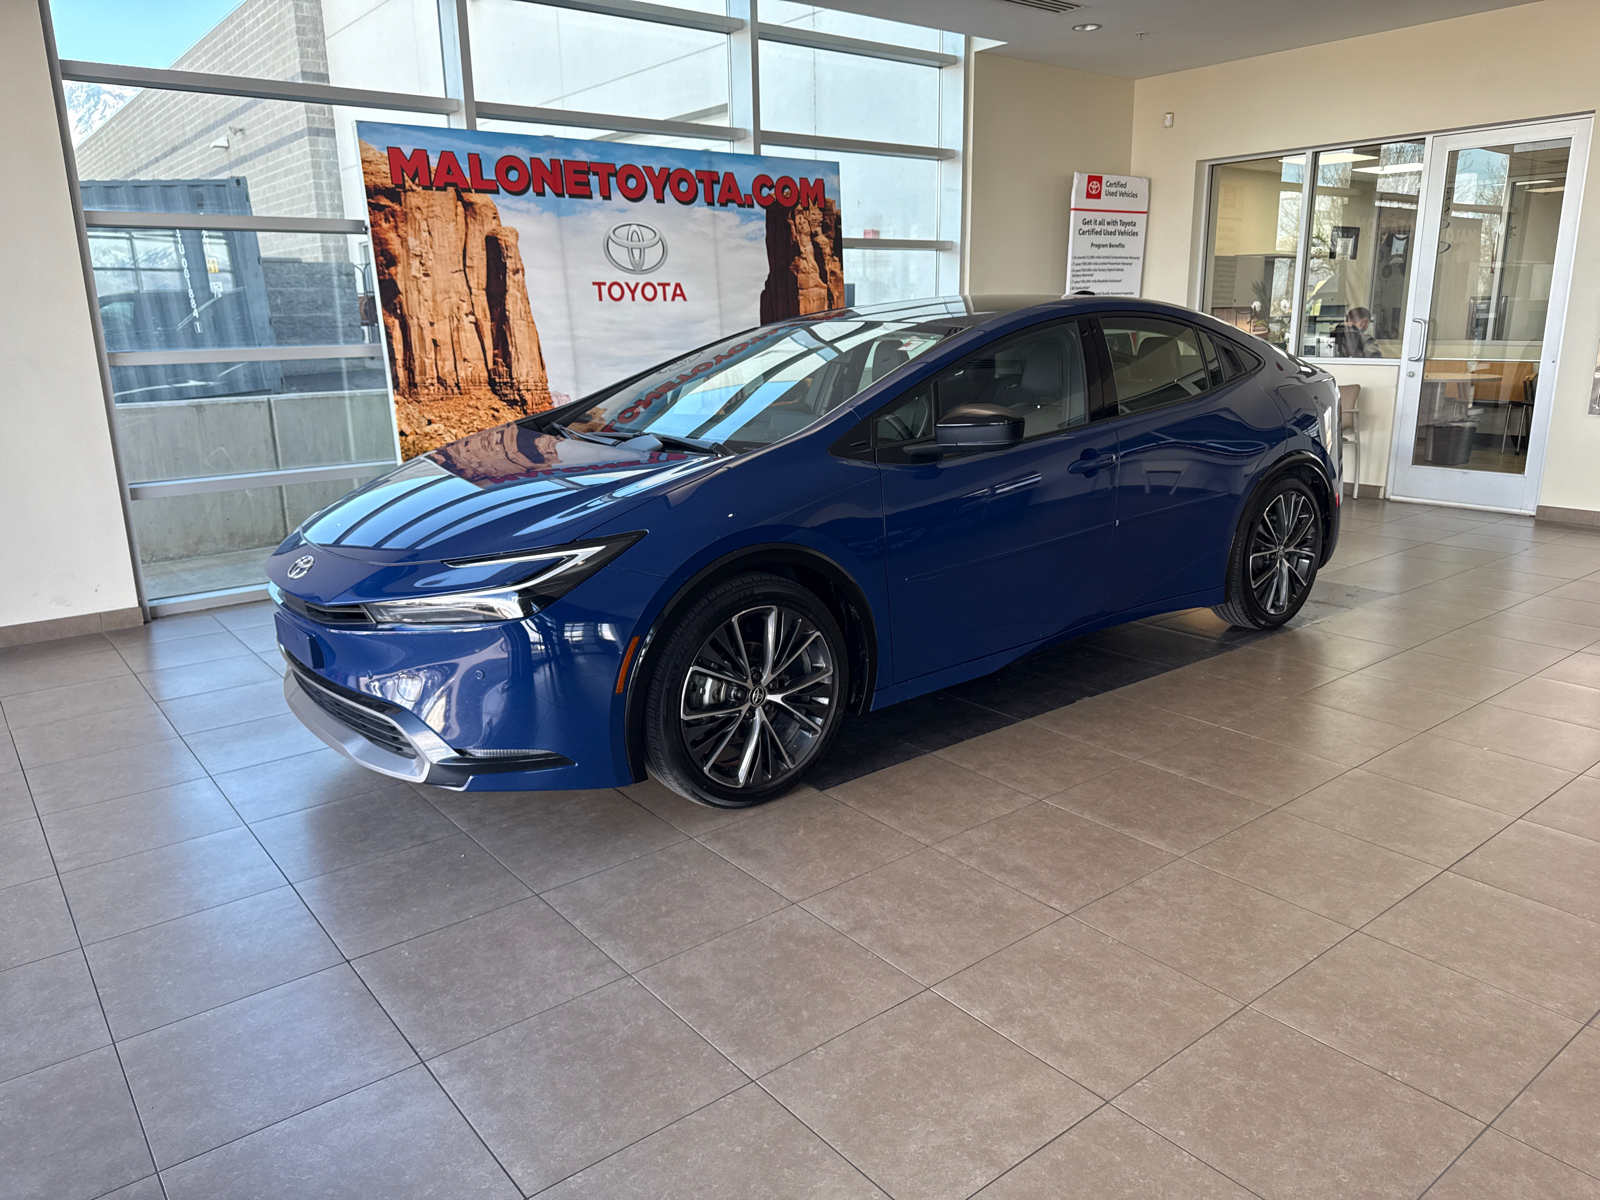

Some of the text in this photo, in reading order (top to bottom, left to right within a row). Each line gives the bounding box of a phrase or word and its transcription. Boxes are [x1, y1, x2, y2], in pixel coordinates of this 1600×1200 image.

[387, 146, 825, 208] MALONETOYOTA.COM
[1105, 180, 1127, 189] Certified
[1104, 189, 1138, 198] Used Vehicles
[1082, 218, 1093, 226] Get
[1106, 219, 1118, 227] with
[1119, 219, 1136, 229] Toyota
[1078, 228, 1102, 236] Certified
[1103, 229, 1117, 237] Used
[1090, 242, 1108, 250] Program
[592, 281, 688, 302] TOYOTA
